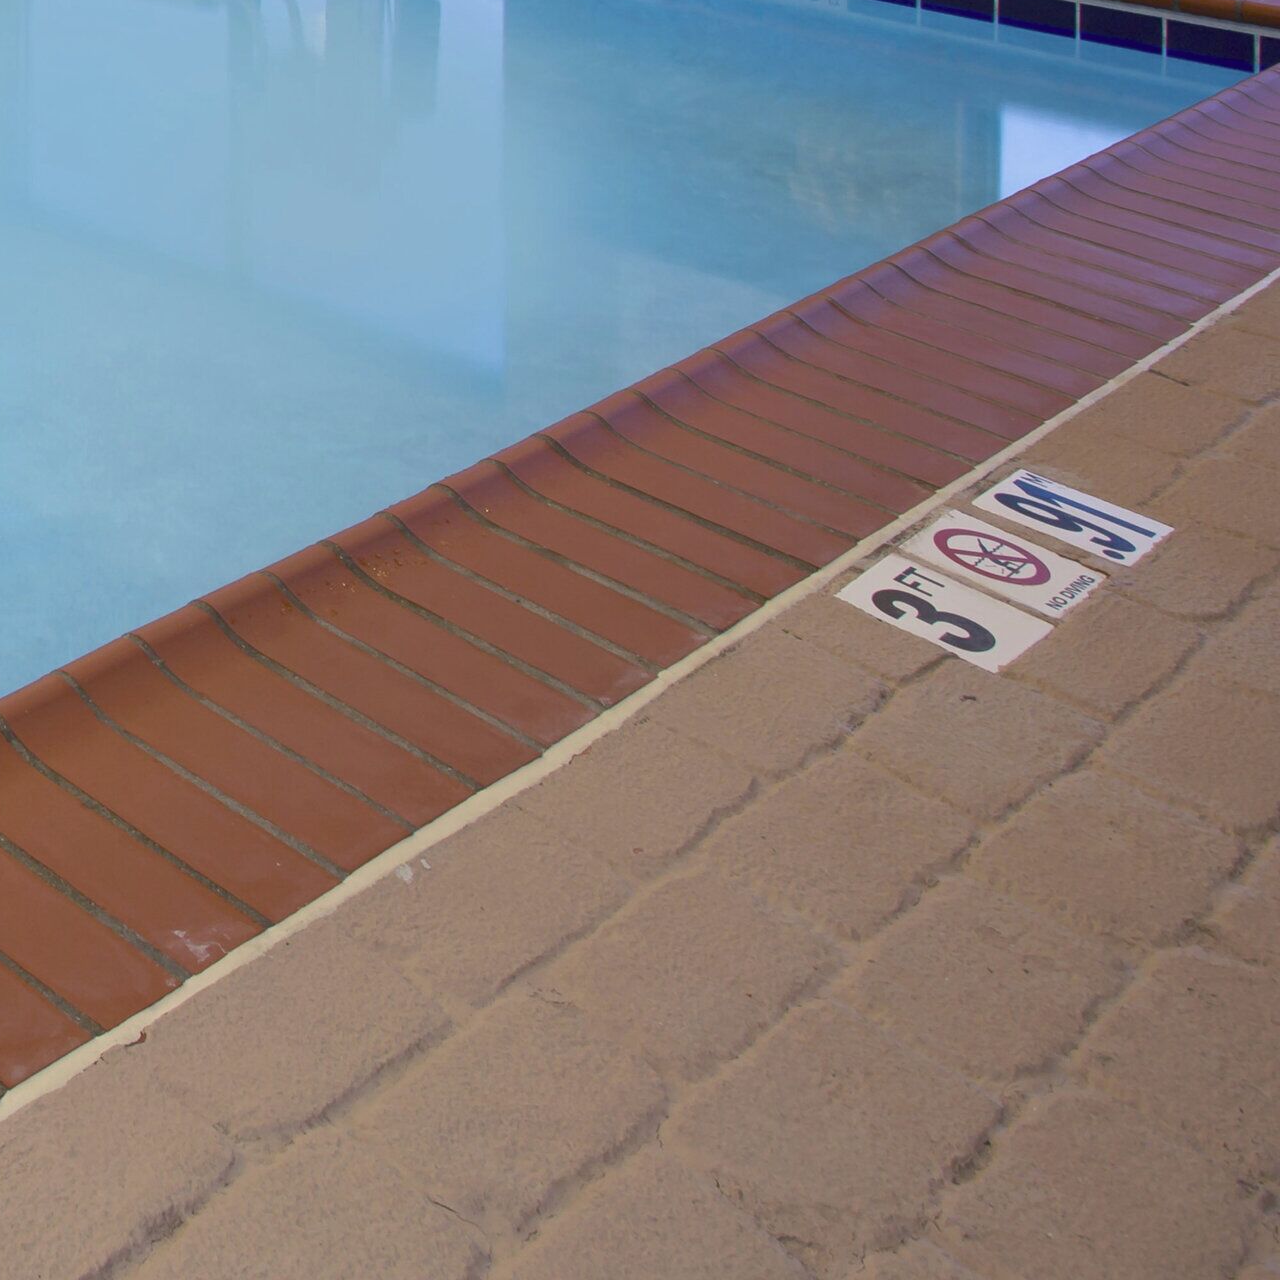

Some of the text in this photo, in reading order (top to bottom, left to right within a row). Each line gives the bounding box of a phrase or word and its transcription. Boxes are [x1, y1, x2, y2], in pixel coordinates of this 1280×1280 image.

[1020, 472, 1054, 489] M
[871, 566, 996, 653] 3 FT
[1046, 574, 1096, 611] NO DIVING
